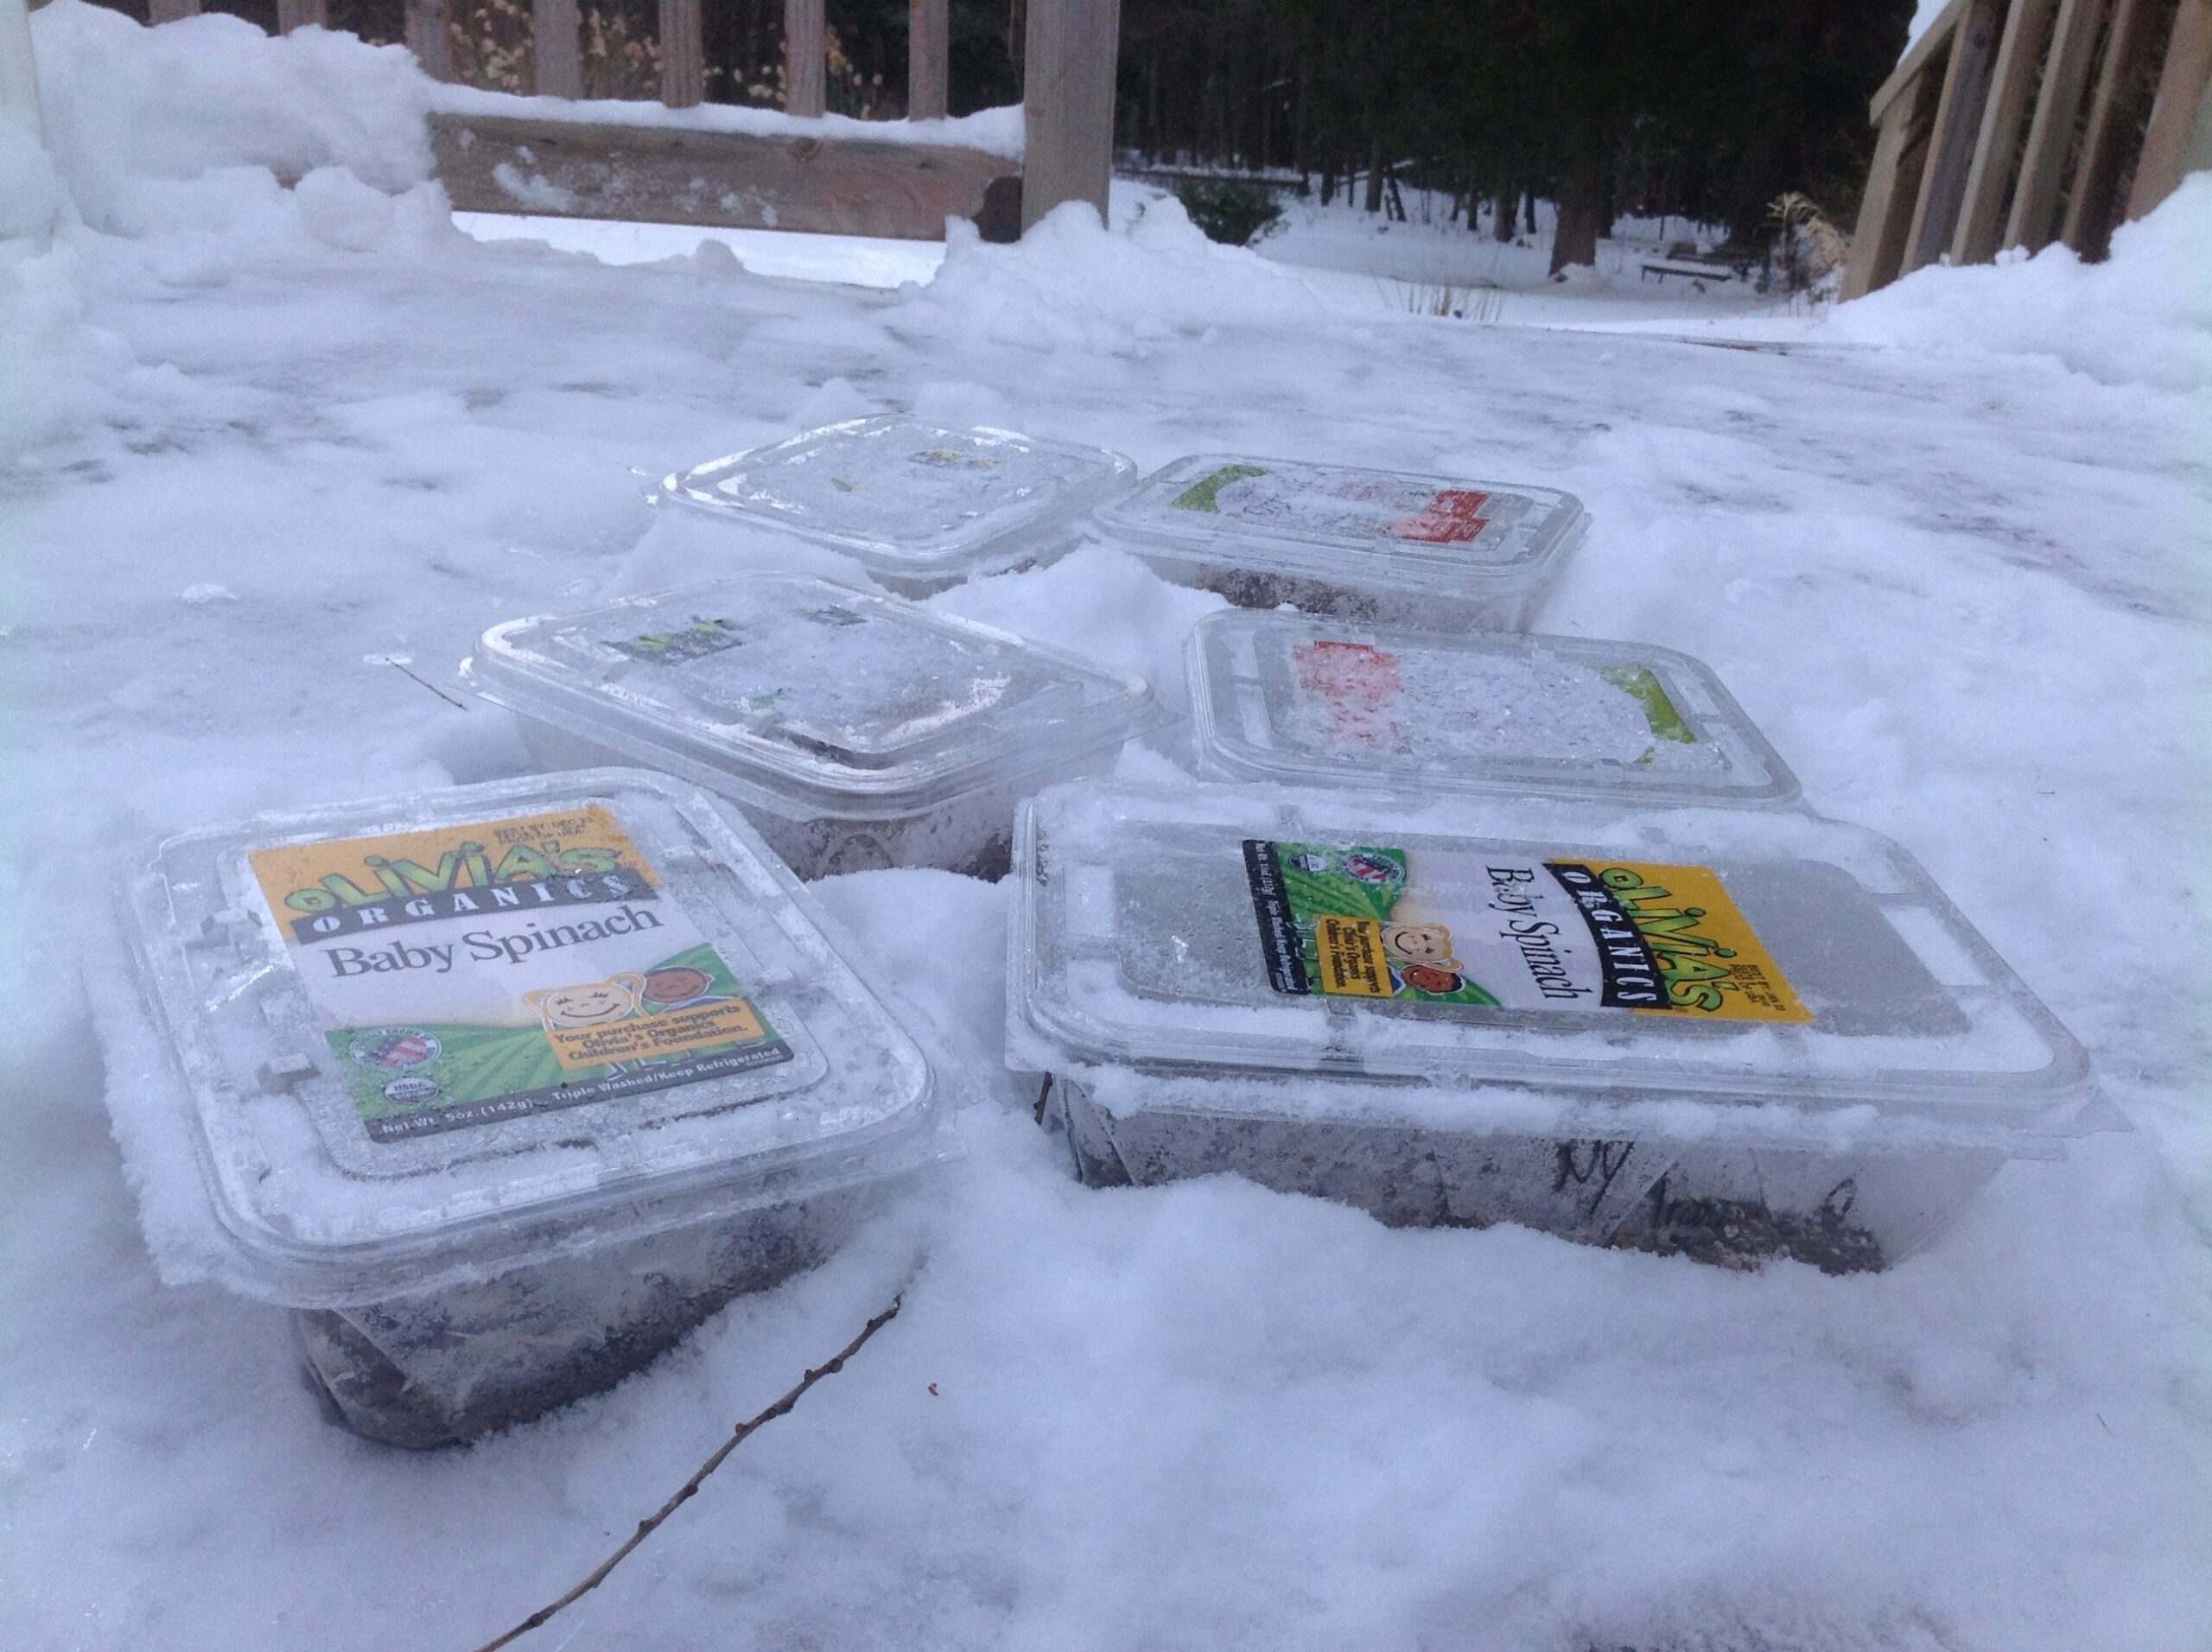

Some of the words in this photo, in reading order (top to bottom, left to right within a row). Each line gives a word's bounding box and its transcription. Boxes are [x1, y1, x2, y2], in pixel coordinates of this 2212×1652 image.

[313, 874, 634, 933] ORGANICS
[1485, 865, 1543, 918] Baby
[324, 940, 457, 977] Baby
[462, 905, 664, 964] Spinach
[1499, 918, 1593, 1000] Spinach
[1561, 871, 1657, 1002] ORGANICS
[555, 1030, 595, 1045] Your
[596, 1020, 667, 1038] purchase
[671, 1003, 741, 1025] supports
[569, 1040, 650, 1062] Children's
[582, 1031, 643, 1050] Olivia's
[648, 1019, 716, 1039] Organics
[480, 1097, 533, 1117] (142g)
[551, 1084, 594, 1102] Triple
[598, 1064, 694, 1093] Washed/Keep
[696, 1047, 780, 1074] Refrigerated
